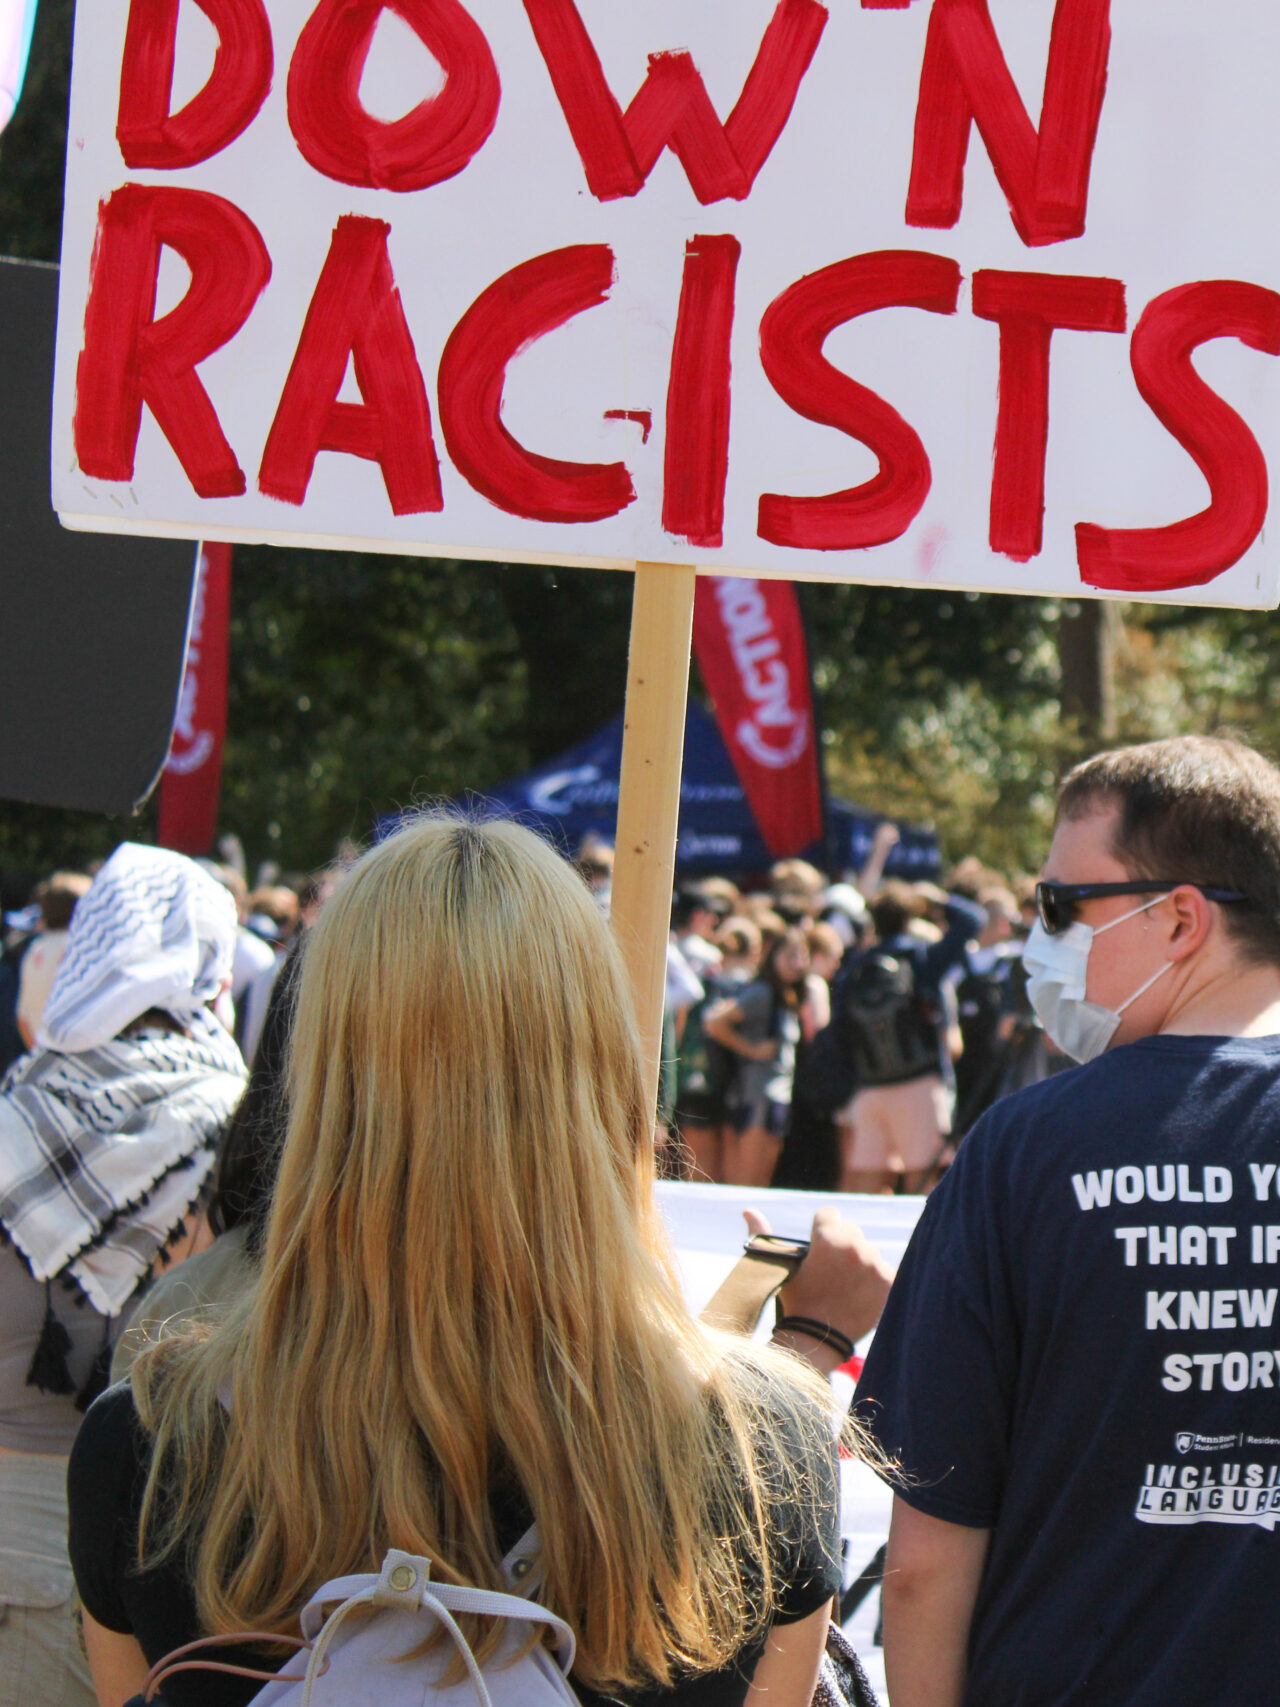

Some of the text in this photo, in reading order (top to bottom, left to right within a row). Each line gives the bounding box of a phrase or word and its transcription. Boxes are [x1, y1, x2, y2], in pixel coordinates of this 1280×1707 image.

[116, 0, 1111, 247] DOWN
[1072, 1164, 1233, 1211] WOULD
[1115, 1226, 1236, 1266] THAT
[1146, 1289, 1278, 1330] KNEW
